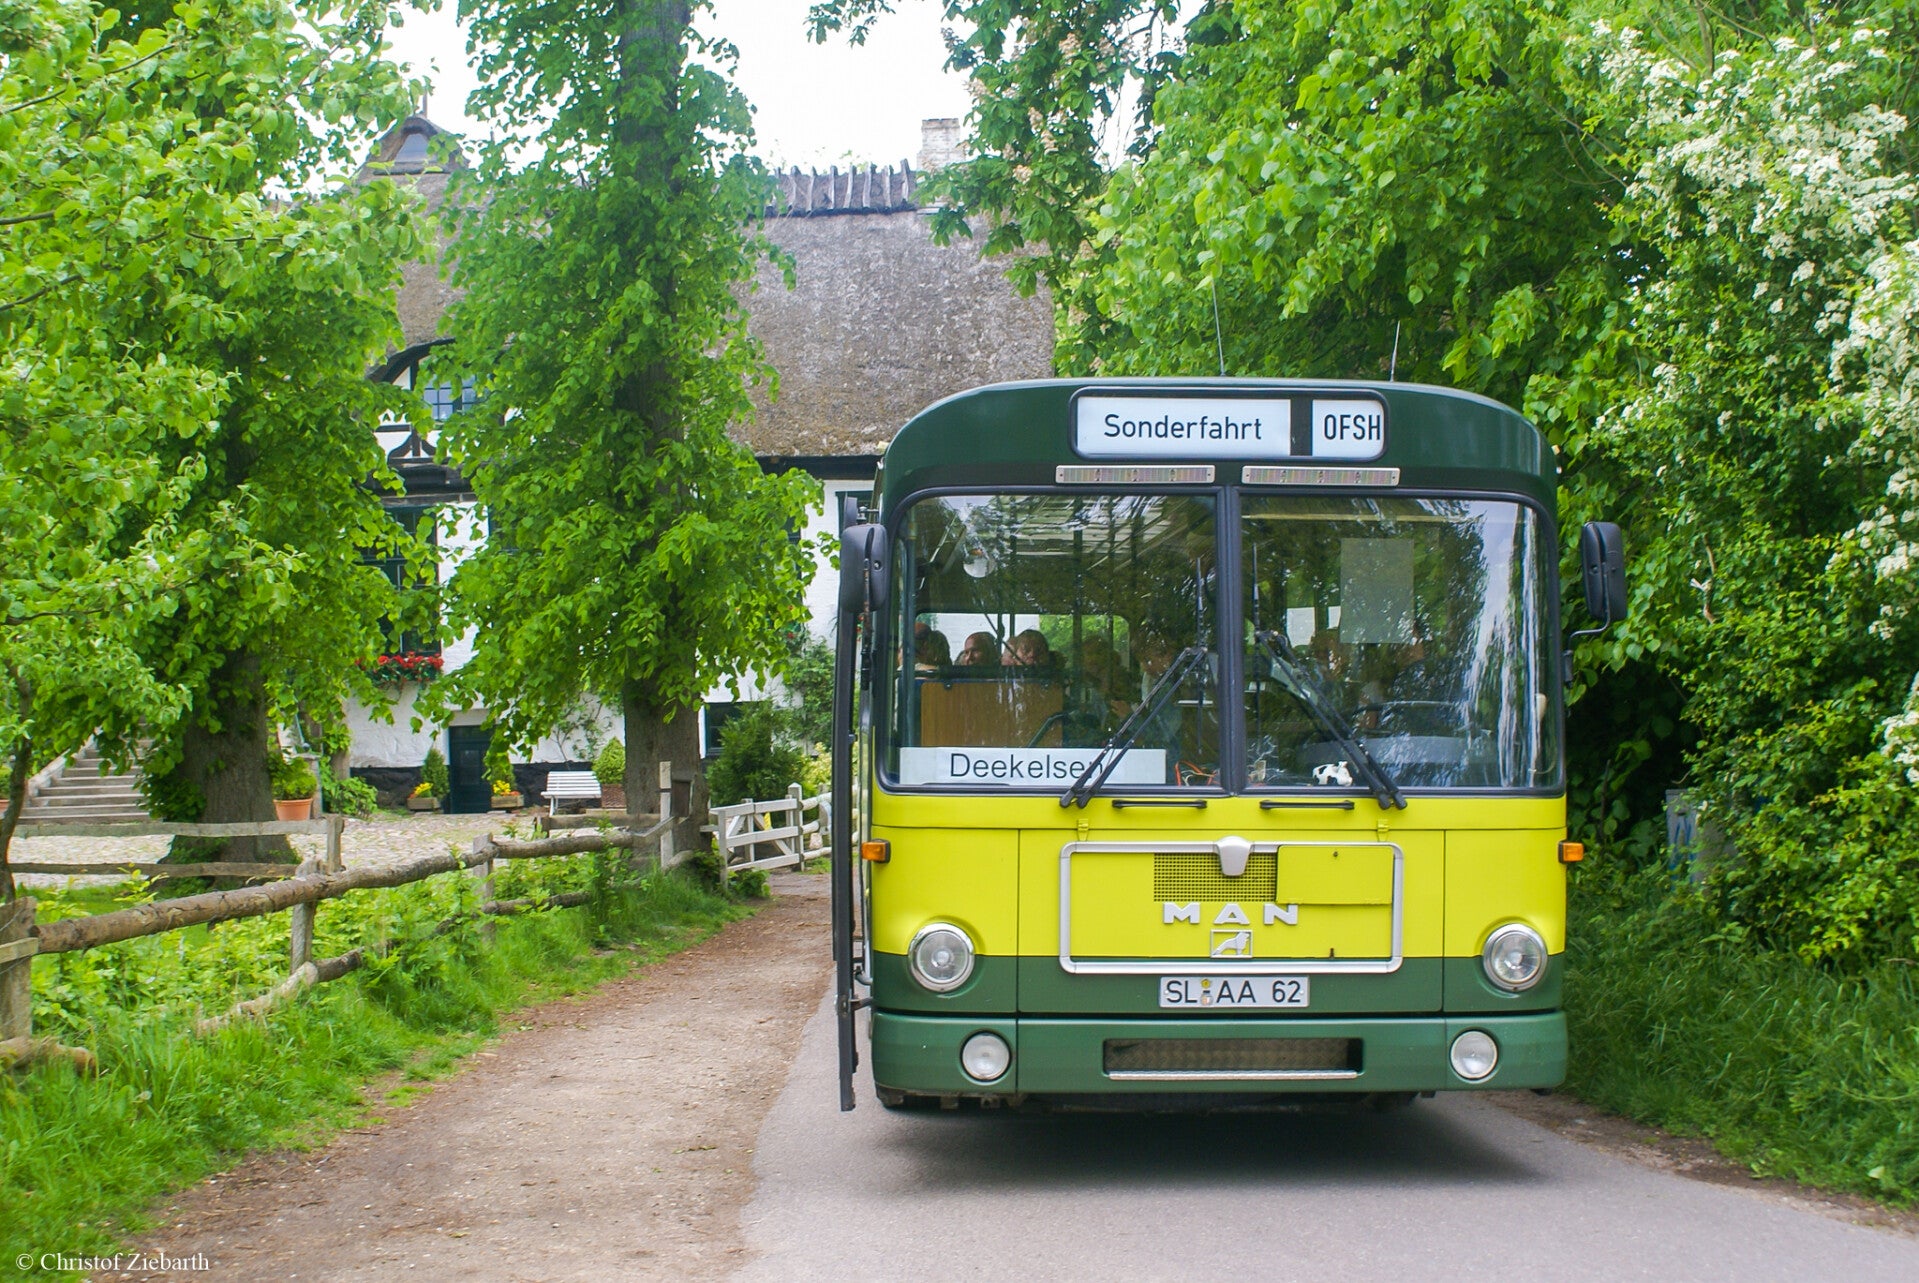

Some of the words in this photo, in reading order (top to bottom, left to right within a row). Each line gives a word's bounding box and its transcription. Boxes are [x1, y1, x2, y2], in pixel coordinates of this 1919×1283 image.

[1104, 414, 1262, 440] Sonderfahrt
[1163, 902, 1298, 925] MAN
[1272, 980, 1301, 1003] 62
